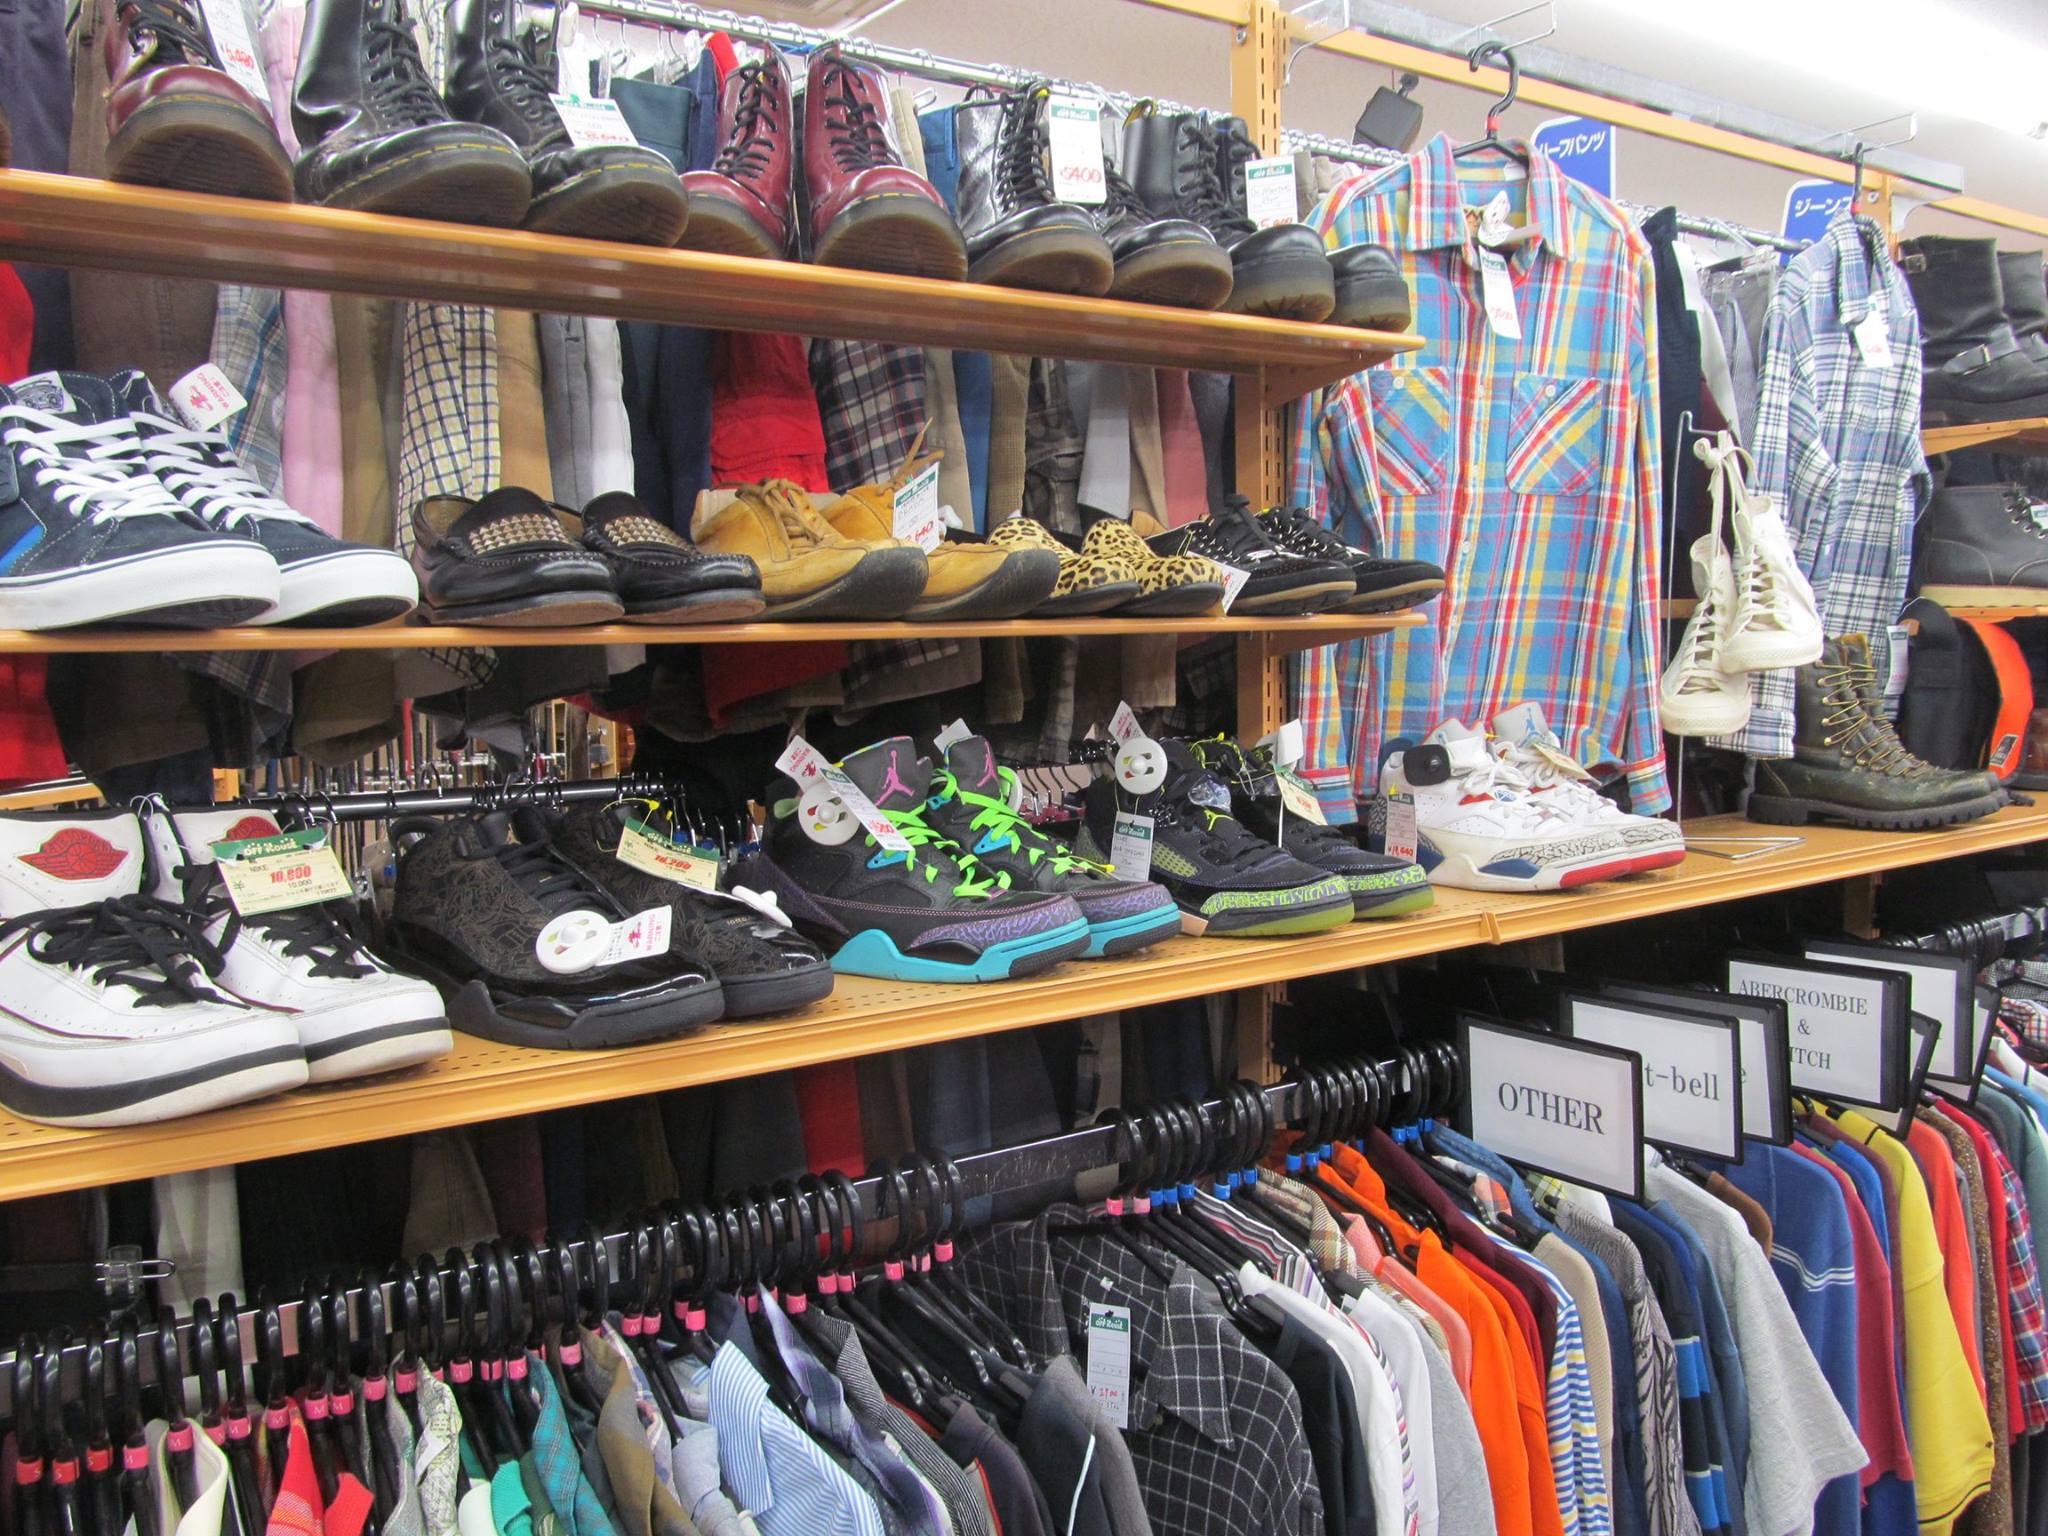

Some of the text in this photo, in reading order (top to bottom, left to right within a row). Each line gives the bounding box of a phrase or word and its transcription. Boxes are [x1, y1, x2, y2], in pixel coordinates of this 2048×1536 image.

[1738, 979, 1867, 1016] ABERCROMBIE
[1797, 1018, 1811, 1036] &
[1498, 1081, 1605, 1135] OTHER
